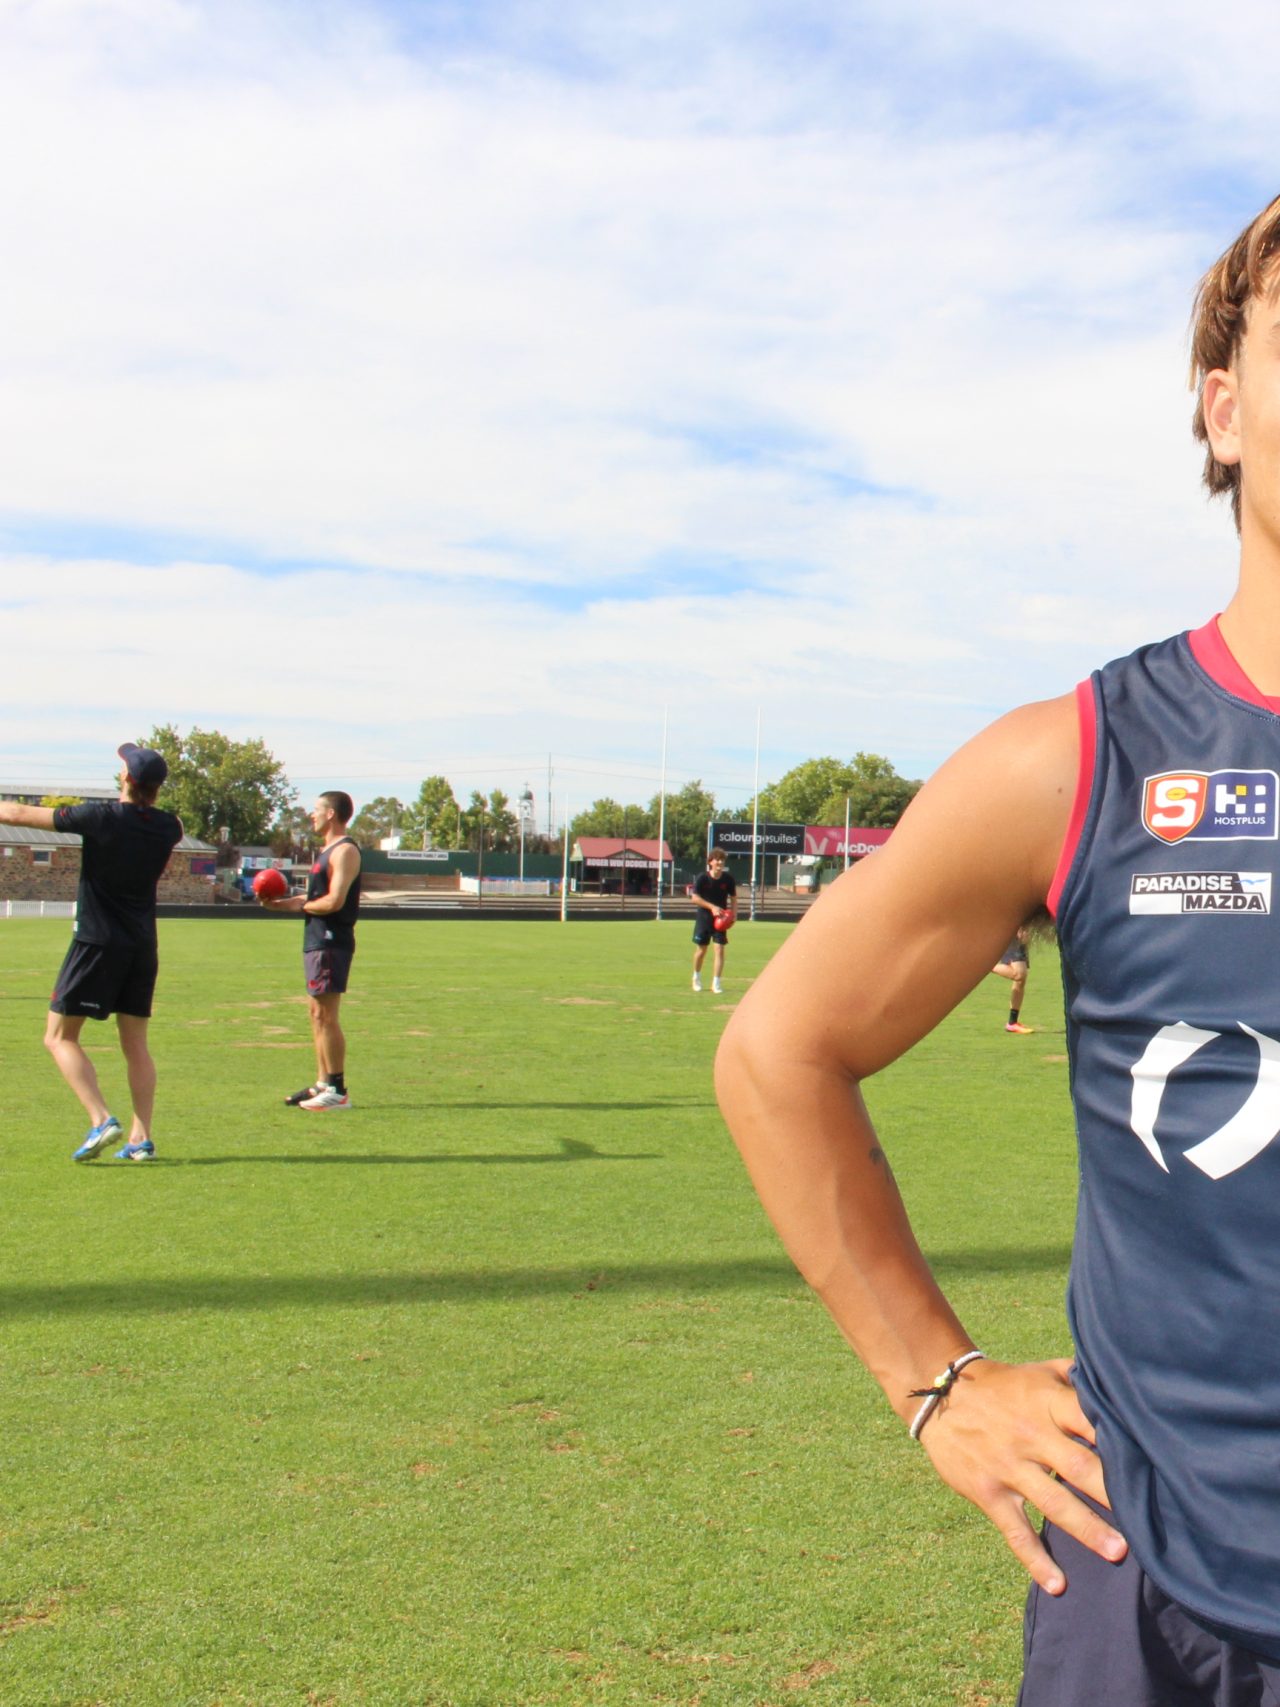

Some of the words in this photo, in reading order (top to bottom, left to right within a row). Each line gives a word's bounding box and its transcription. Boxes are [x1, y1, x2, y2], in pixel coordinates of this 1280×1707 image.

[1214, 816, 1266, 826] HOSTPLUS
[1135, 875, 1233, 893] PARADISE
[1185, 894, 1263, 910] MAZDA
